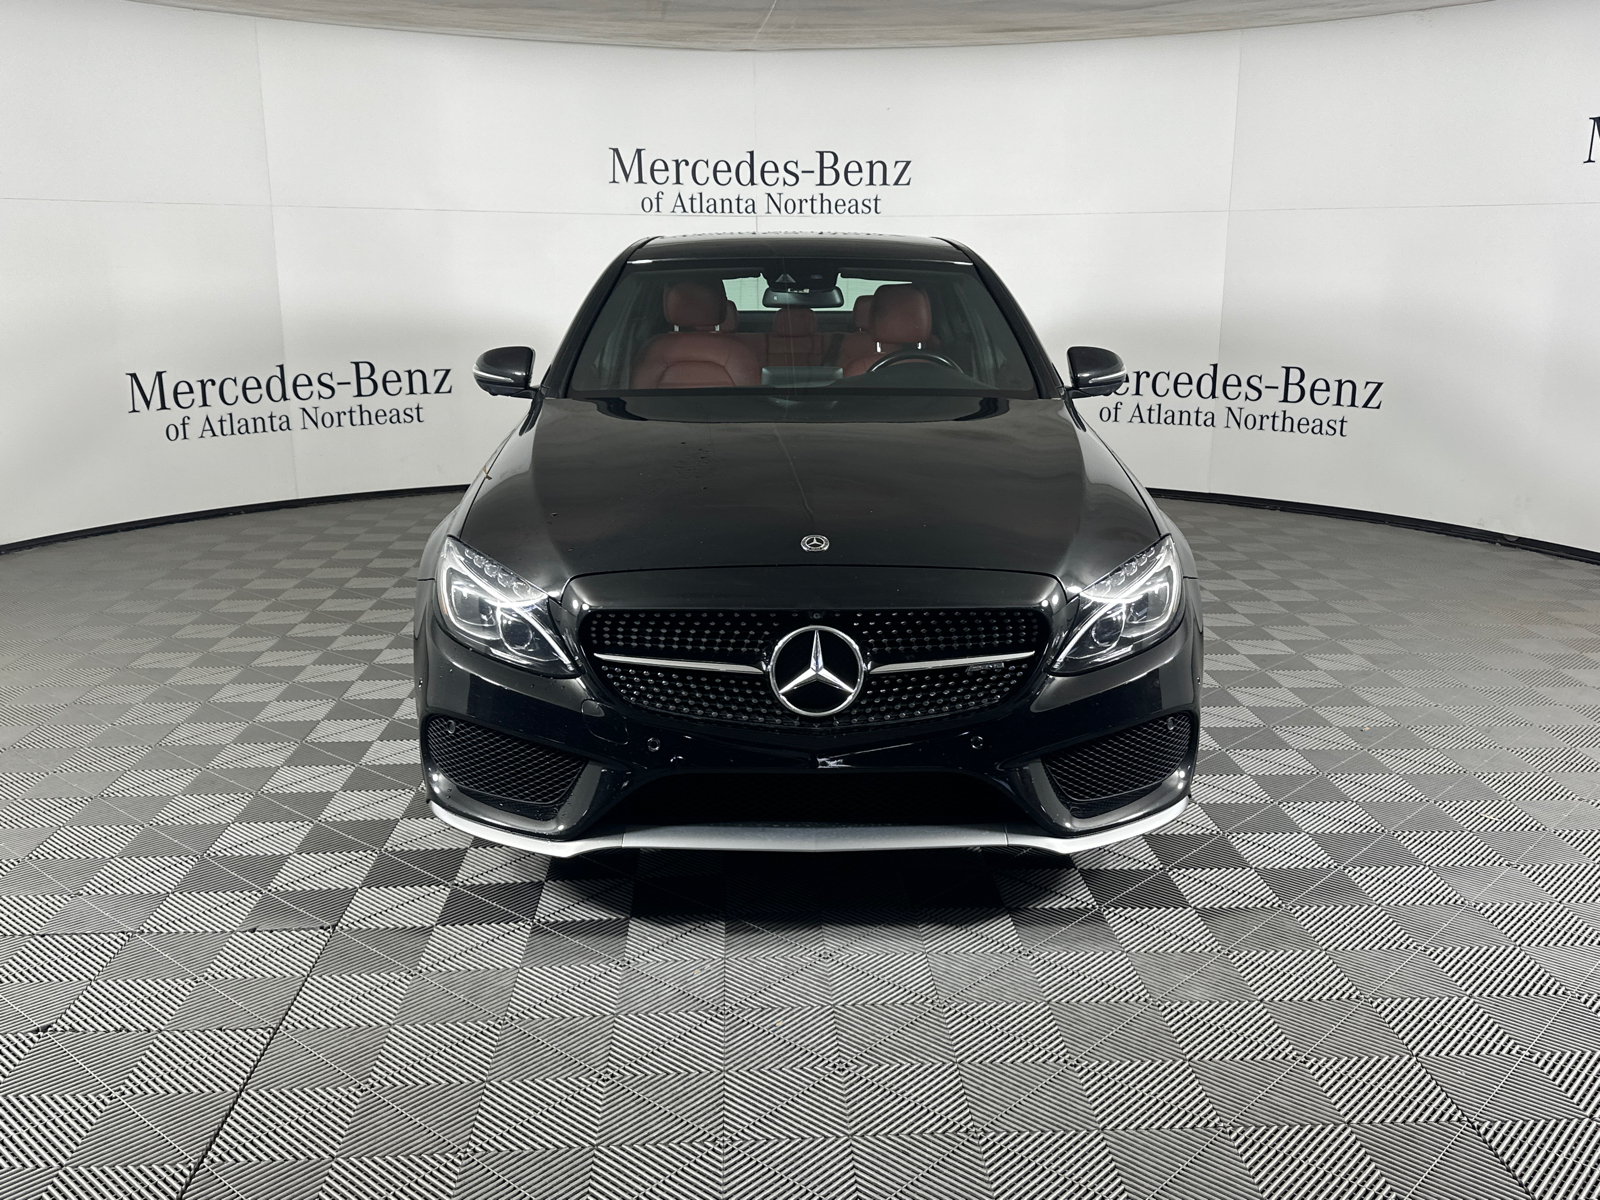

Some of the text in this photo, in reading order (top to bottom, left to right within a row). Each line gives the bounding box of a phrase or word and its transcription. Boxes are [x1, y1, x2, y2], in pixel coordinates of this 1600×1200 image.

[609, 147, 912, 187] Mercedes-Benz
[641, 191, 882, 215] of Atlanta Northeast
[126, 360, 453, 413] Mercedes-Benz
[1113, 363, 1385, 410] ercedes-Benz
[165, 402, 424, 442] of Atlanta Northeast
[1099, 401, 1348, 437] of Atlanta Northeast
